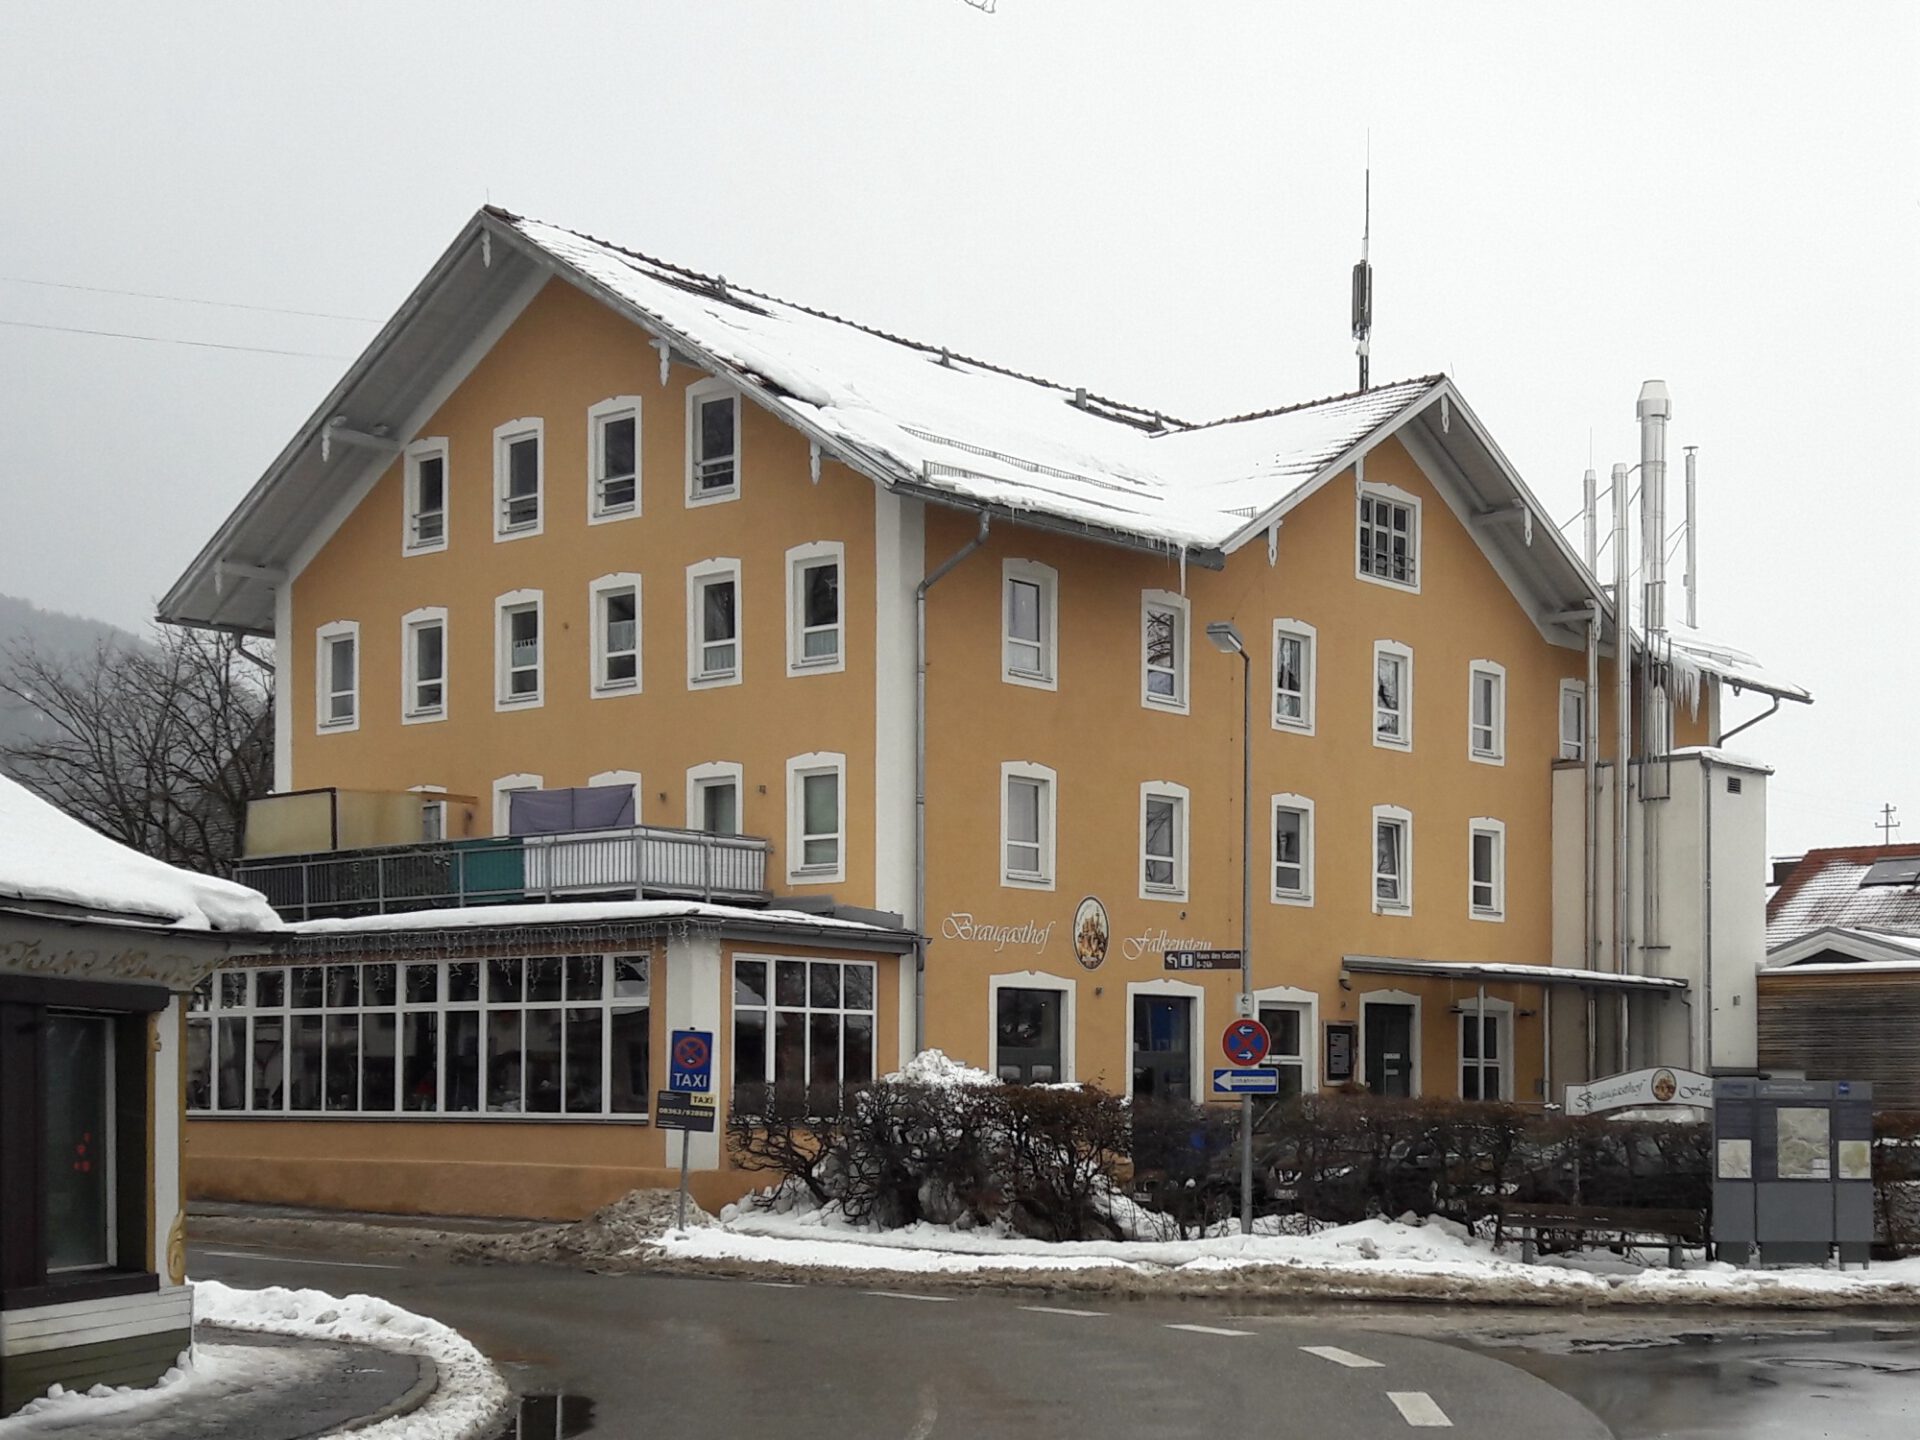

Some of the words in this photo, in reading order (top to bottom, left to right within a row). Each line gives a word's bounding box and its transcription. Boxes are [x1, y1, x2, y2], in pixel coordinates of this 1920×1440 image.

[942, 912, 1056, 954] Braugasthof
[1122, 928, 1212, 960] Falkenstein
[673, 1072, 707, 1088] TAXI
[693, 1095, 713, 1105] TAXI
